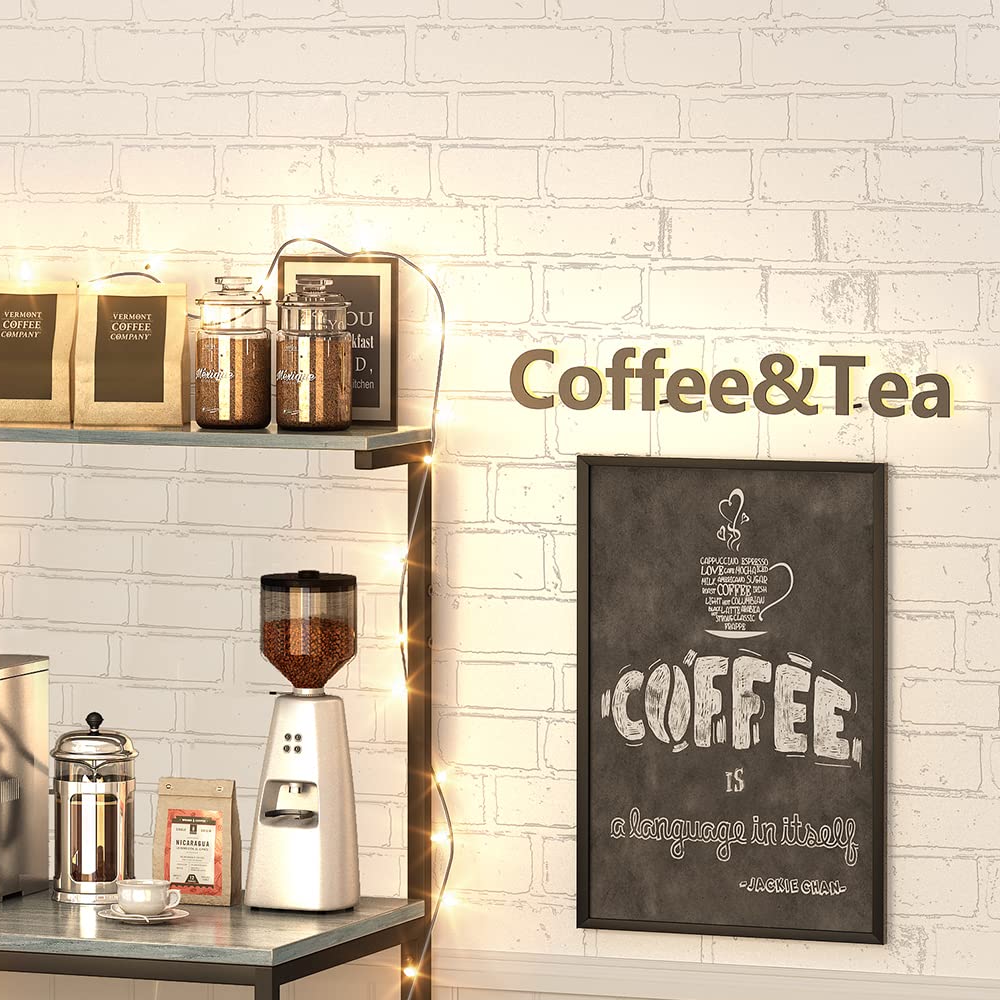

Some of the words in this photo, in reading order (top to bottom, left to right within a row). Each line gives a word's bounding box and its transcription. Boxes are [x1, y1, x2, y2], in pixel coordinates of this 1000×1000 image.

[2, 320, 41, 329] COFFEE
[111, 322, 151, 331] COFFEE
[509, 347, 952, 418] Coffee&Tea
[700, 565, 724, 576] LOVE
[735, 566, 757, 575] MOCHA
[746, 575, 768, 585] SUGAR
[717, 583, 752, 596] COFFEE
[612, 655, 852, 759] COFFEE
[725, 768, 745, 792] IS
[175, 839, 210, 847] NICARAGUA
[610, 817, 626, 839] a
[629, 807, 748, 862] language
[751, 815, 778, 846] in
[781, 813, 860, 867] itself
